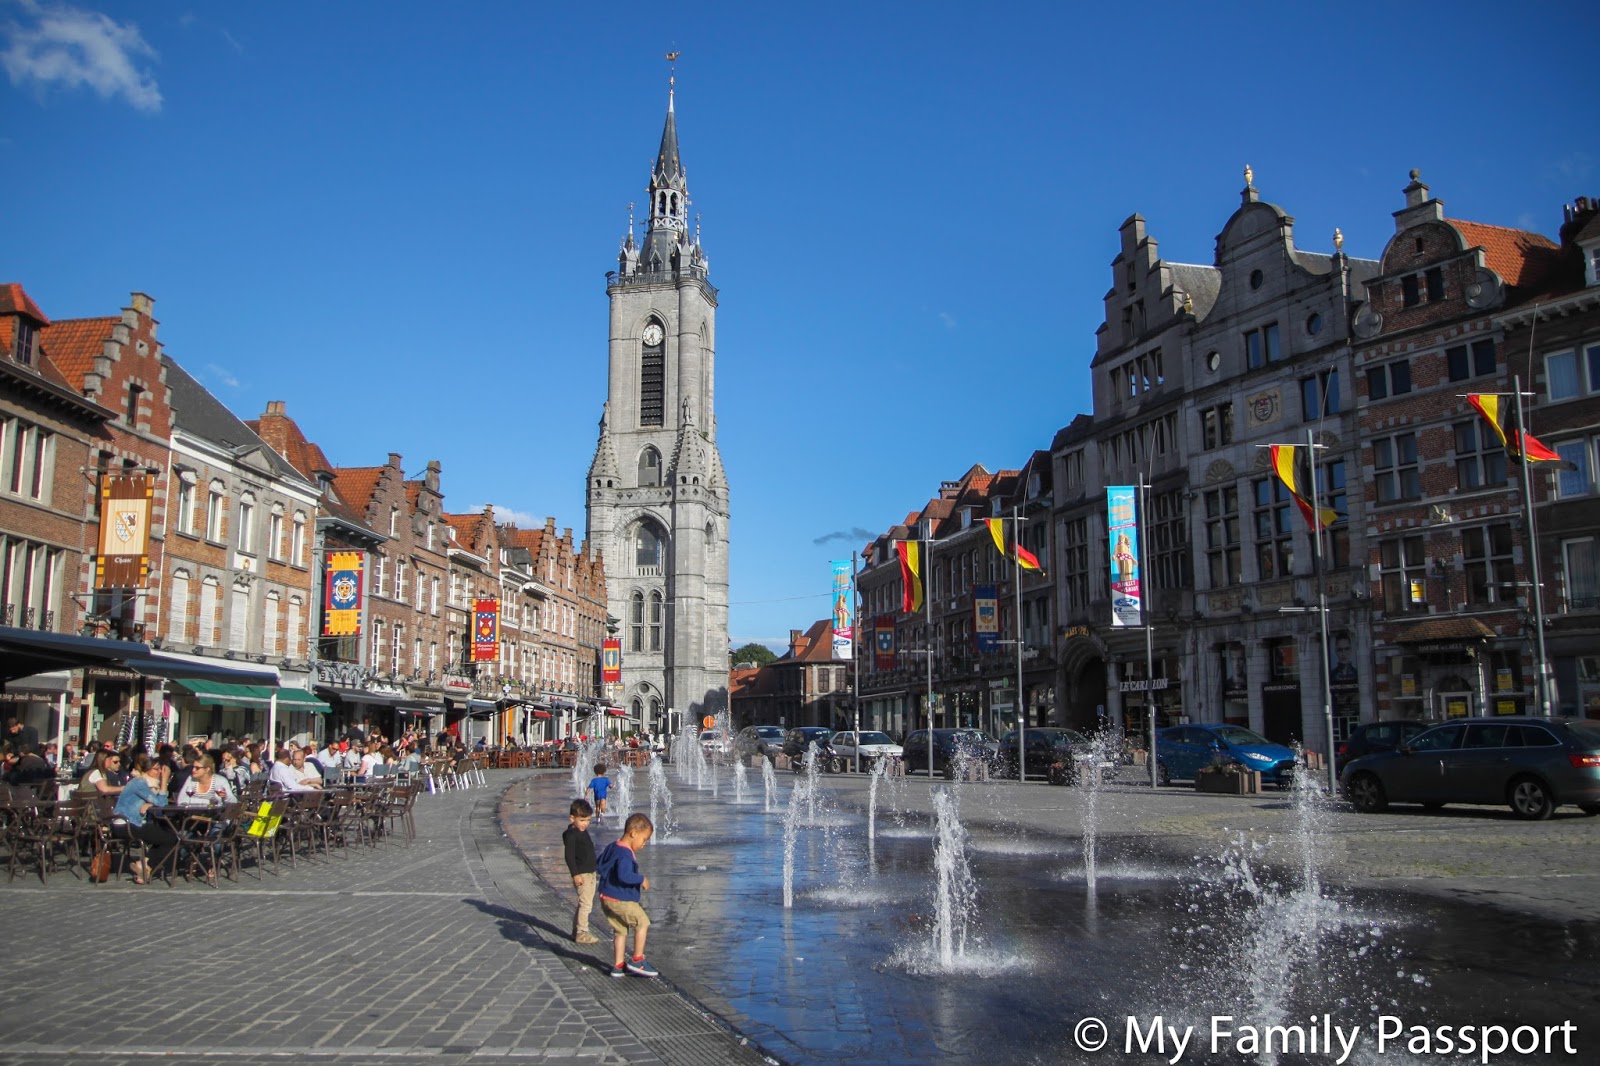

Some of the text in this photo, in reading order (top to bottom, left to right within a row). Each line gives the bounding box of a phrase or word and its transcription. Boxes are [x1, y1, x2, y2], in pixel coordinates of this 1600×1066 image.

[1119, 678, 1169, 692] LE CARILON
[32, 693, 52, 701] Dimanche
